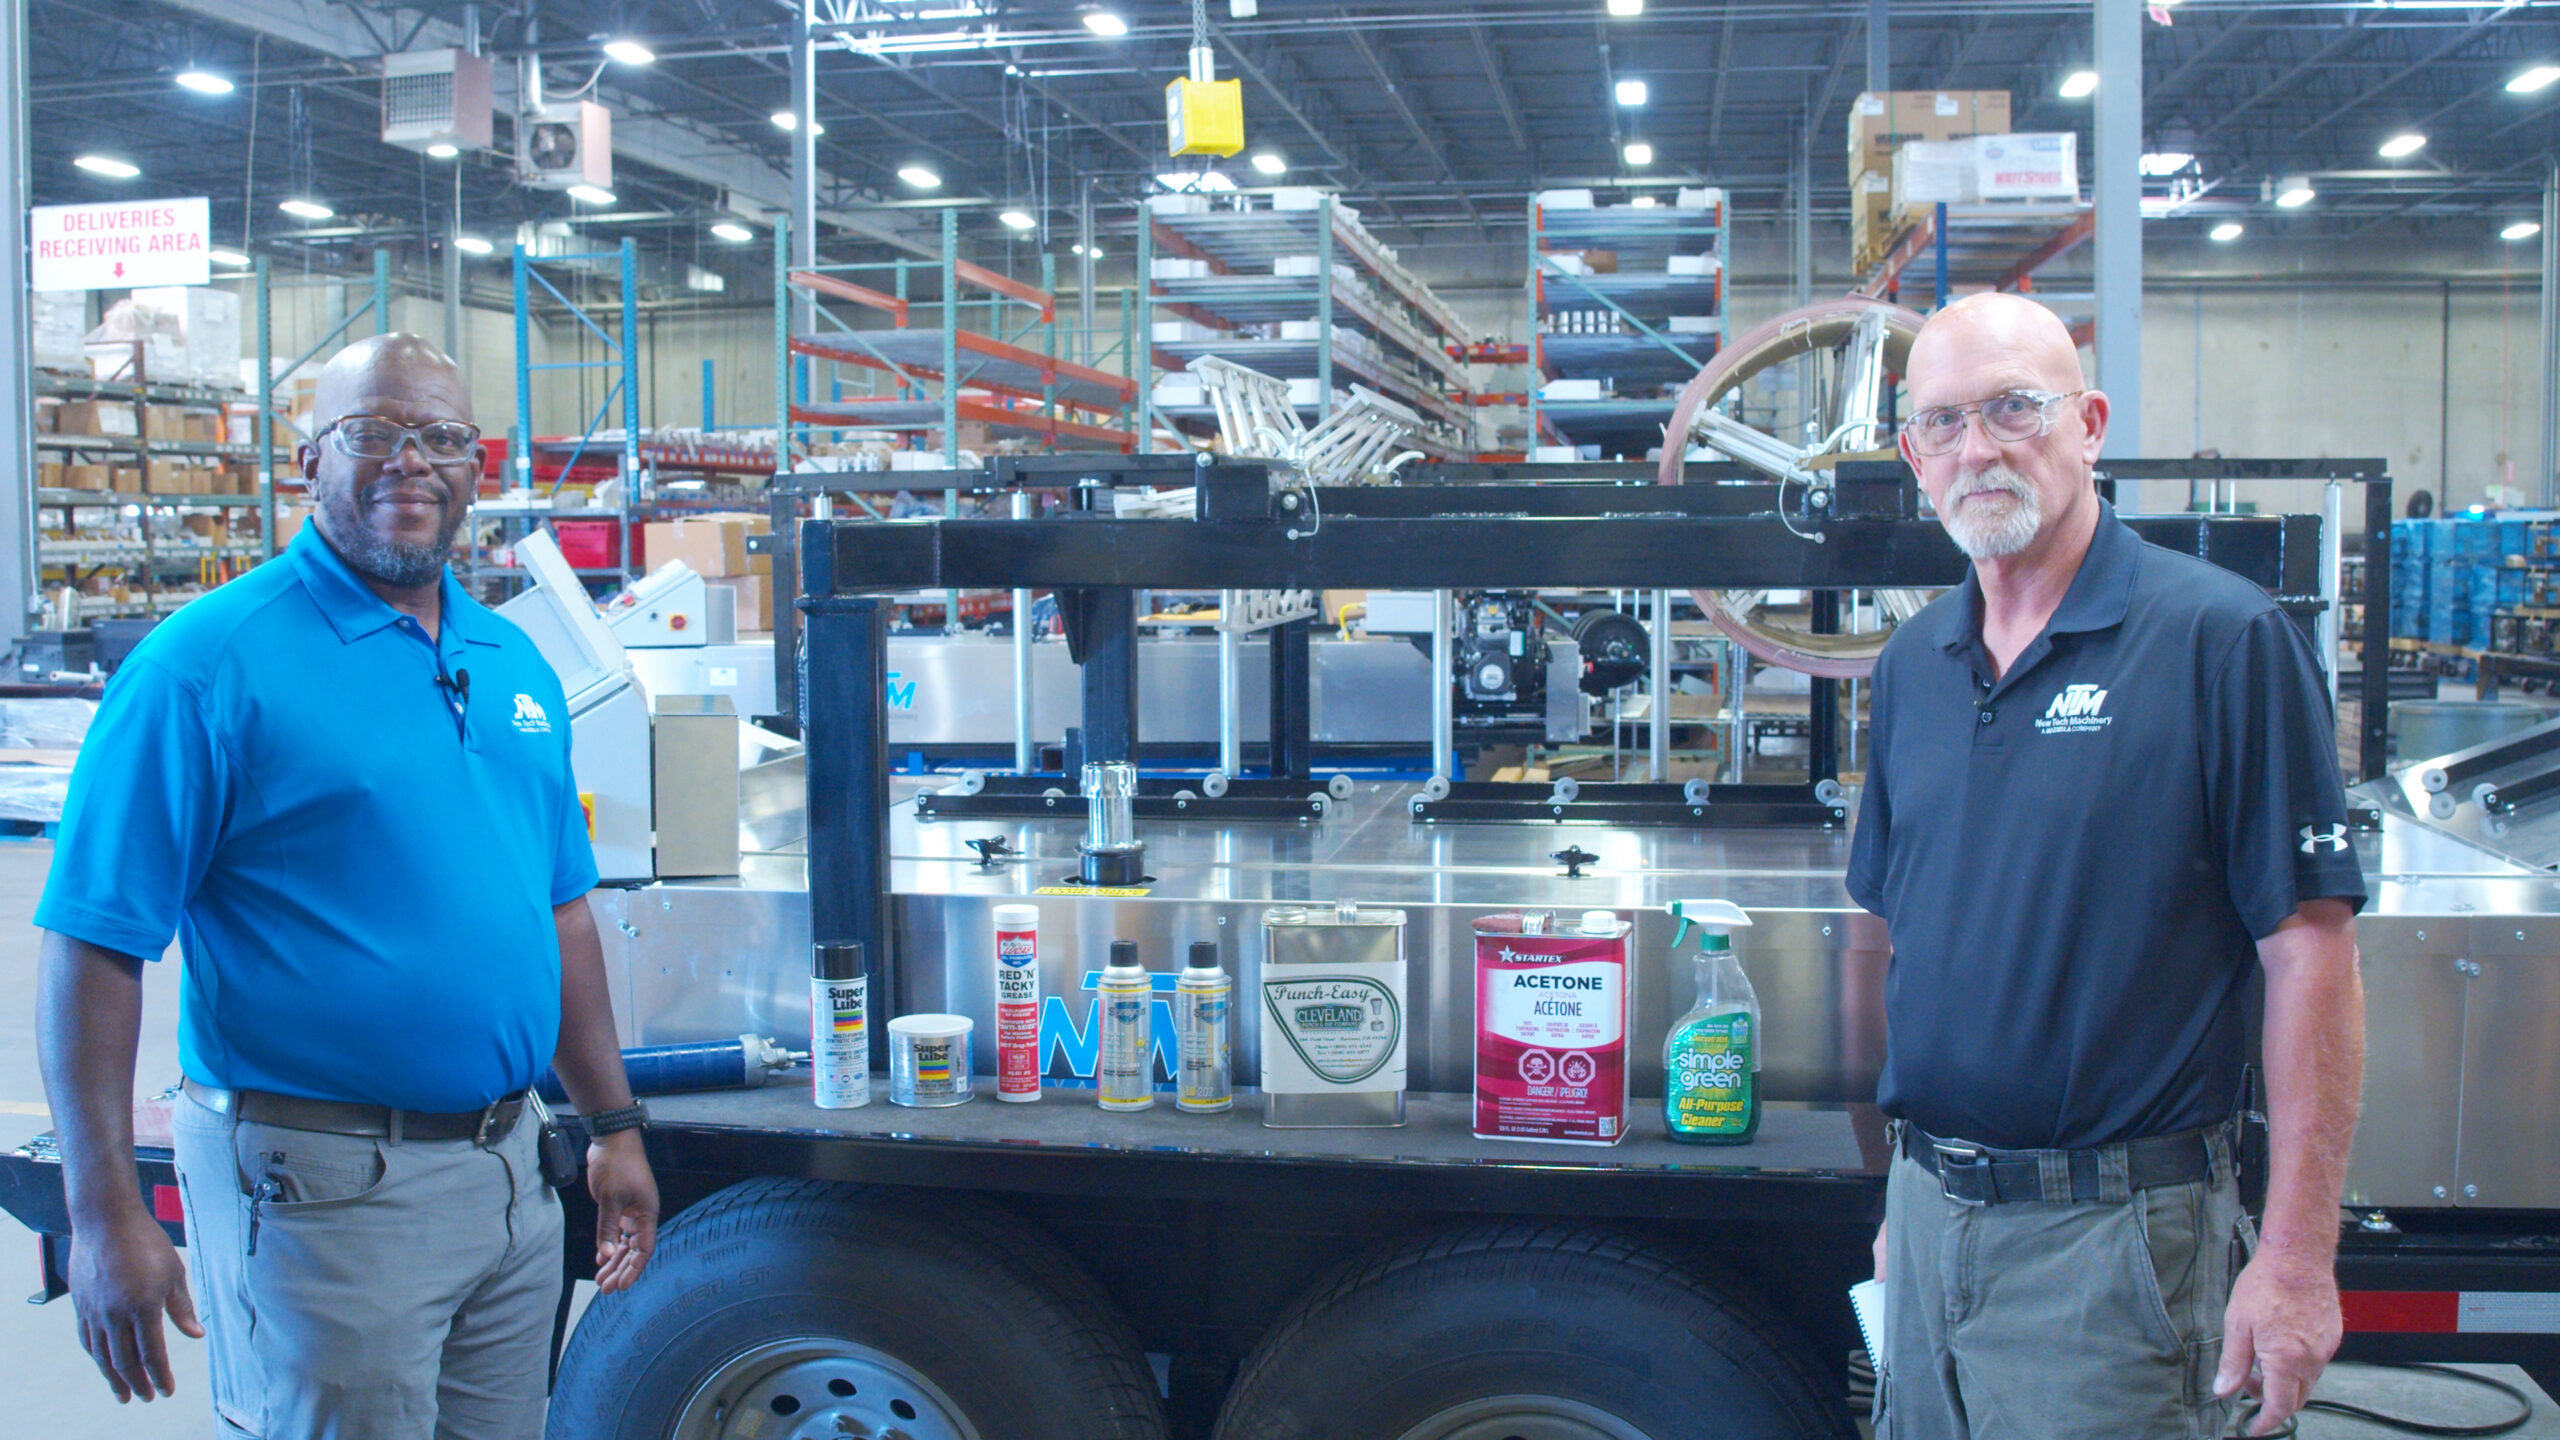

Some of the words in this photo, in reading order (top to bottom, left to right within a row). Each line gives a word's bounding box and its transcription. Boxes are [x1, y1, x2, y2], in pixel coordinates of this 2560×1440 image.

[64, 208, 175, 232] DELIVERIES
[39, 235, 141, 258] RECEIVING
[148, 233, 201, 252] AREA
[2045, 684, 2108, 718] NTM
[2035, 718, 2051, 727] New
[2052, 717, 2068, 726] Tech
[2069, 716, 2112, 726] Machinery
[1515, 953, 1562, 963] STARTEX
[999, 970, 1022, 980] RED
[999, 981, 1035, 991] TACKY
[1514, 975, 1603, 990] ACETONE
[828, 986, 864, 1000] Super
[1274, 984, 1370, 1003] Punch-Easy
[833, 999, 863, 1011] Lube
[1534, 997, 1582, 1017] ACÉTONE
[1297, 1008, 1362, 1022] CLEVELAND
[913, 1044, 951, 1053] Super
[918, 1052, 948, 1061] Lube
[1679, 1048, 1743, 1073] simple
[1680, 1072, 1741, 1091] green
[1197, 1087, 1214, 1096] 202
[1527, 1085, 1554, 1096] DANGER!
[1678, 1097, 1744, 1113] All-Purpose
[1681, 1113, 1726, 1127] Cleaner
